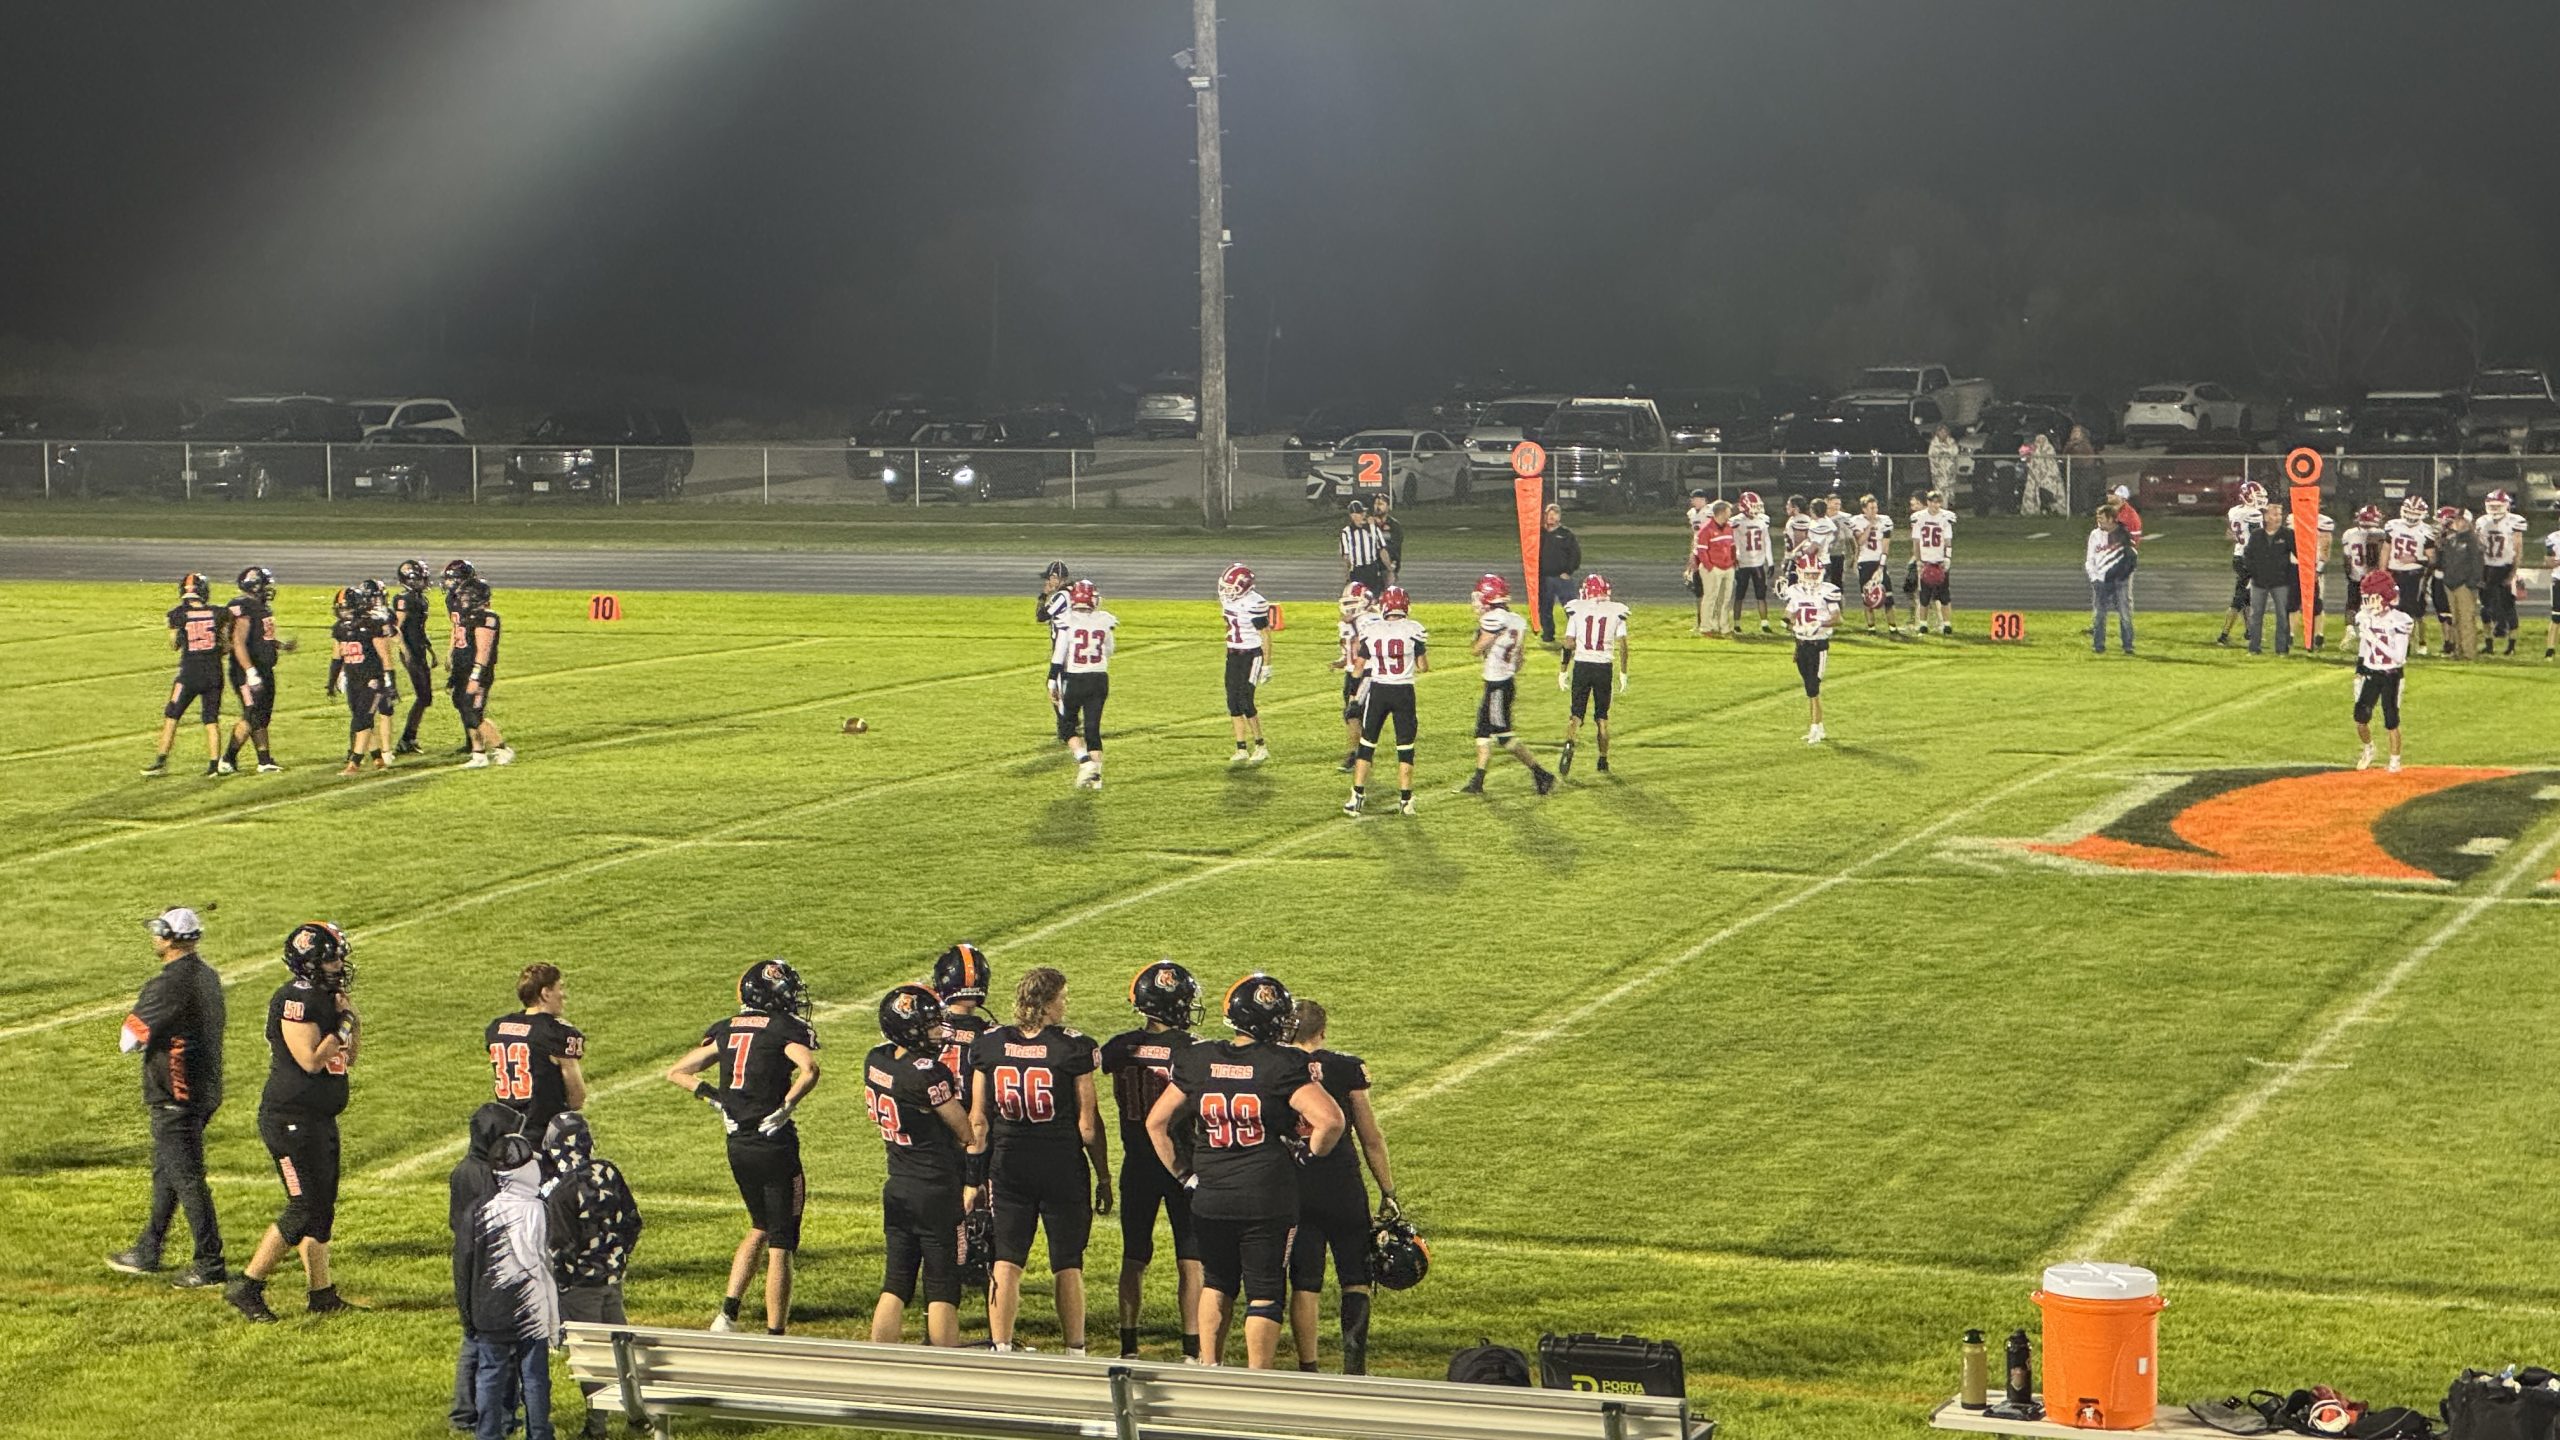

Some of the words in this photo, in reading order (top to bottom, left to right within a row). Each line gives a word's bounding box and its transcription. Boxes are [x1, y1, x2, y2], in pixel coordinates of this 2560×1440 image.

[1358, 453, 1383, 481] 2
[1745, 529, 1762, 551] 12
[1921, 526, 1942, 547] 26
[2394, 537, 2418, 560] 55
[2487, 535, 2505, 557] 17
[592, 596, 614, 620] 10
[1584, 615, 1608, 652] 11
[1994, 613, 2020, 638] 30
[1073, 629, 1105, 664] 23
[1373, 638, 1405, 675] 19
[283, 999, 305, 1020] 50
[727, 1032, 754, 1089] 7
[1004, 1042, 1047, 1059] TIGERS
[489, 1042, 533, 1100] 33
[1210, 1063, 1254, 1079] TIGERS
[928, 1080, 952, 1106] 22
[994, 1065, 1055, 1123] 66
[864, 1085, 912, 1146] 22
[1200, 1092, 1265, 1147] 99
[1602, 1380, 1645, 1393] PORTA
